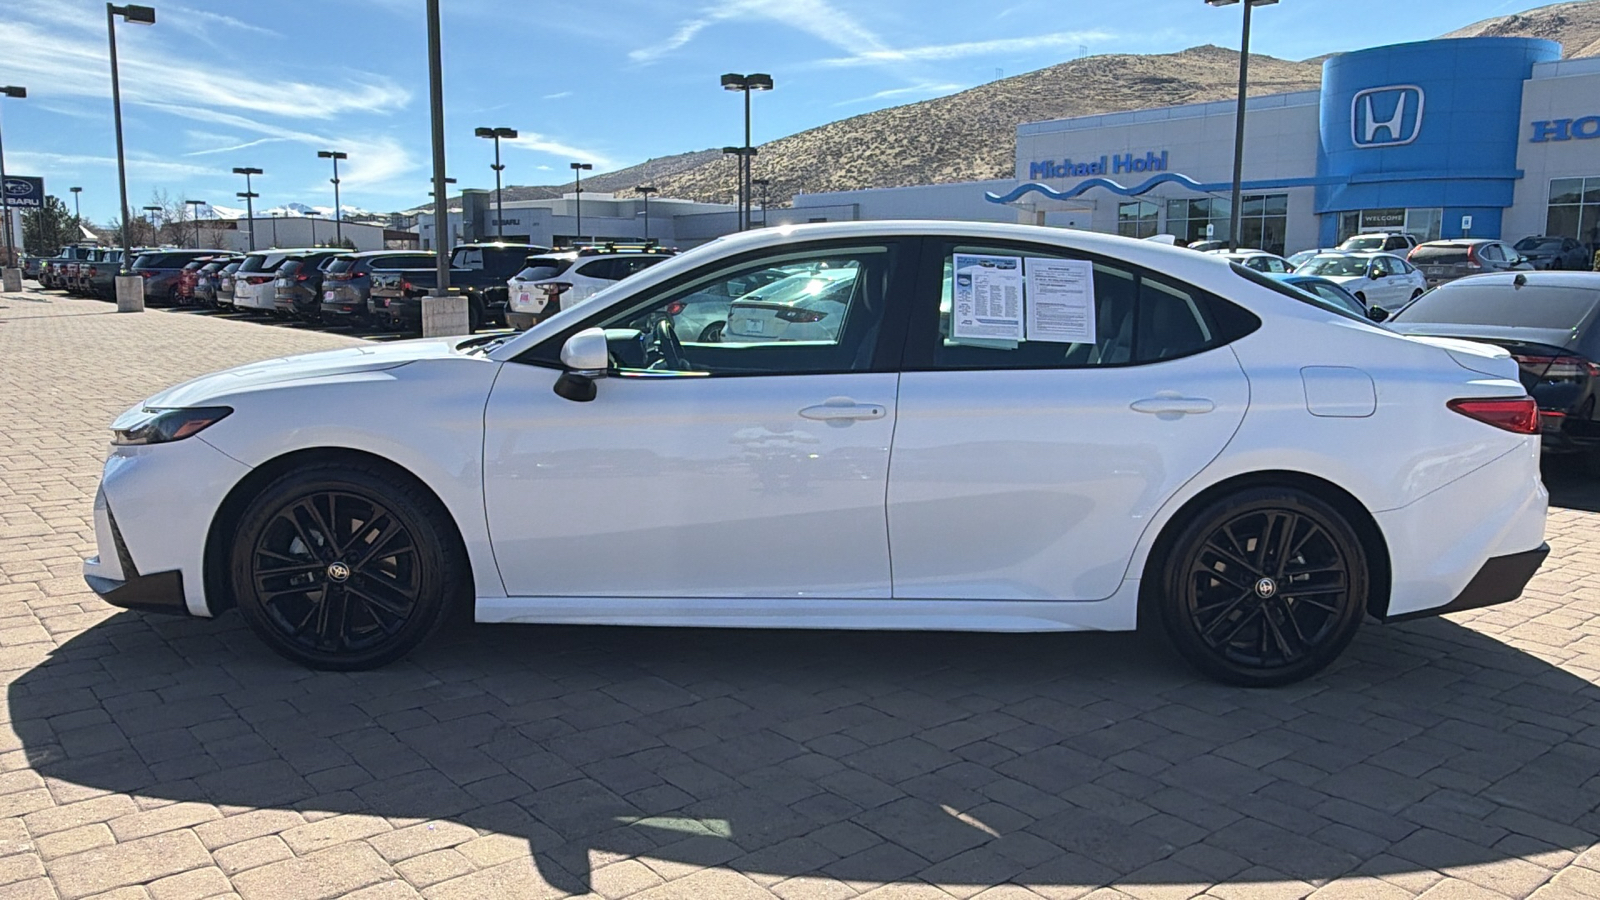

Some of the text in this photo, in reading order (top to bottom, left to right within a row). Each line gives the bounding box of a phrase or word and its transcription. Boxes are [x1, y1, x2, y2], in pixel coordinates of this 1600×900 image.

[1030, 150, 1168, 180] Michael Hohl
[1365, 214, 1403, 222] WELCOME
